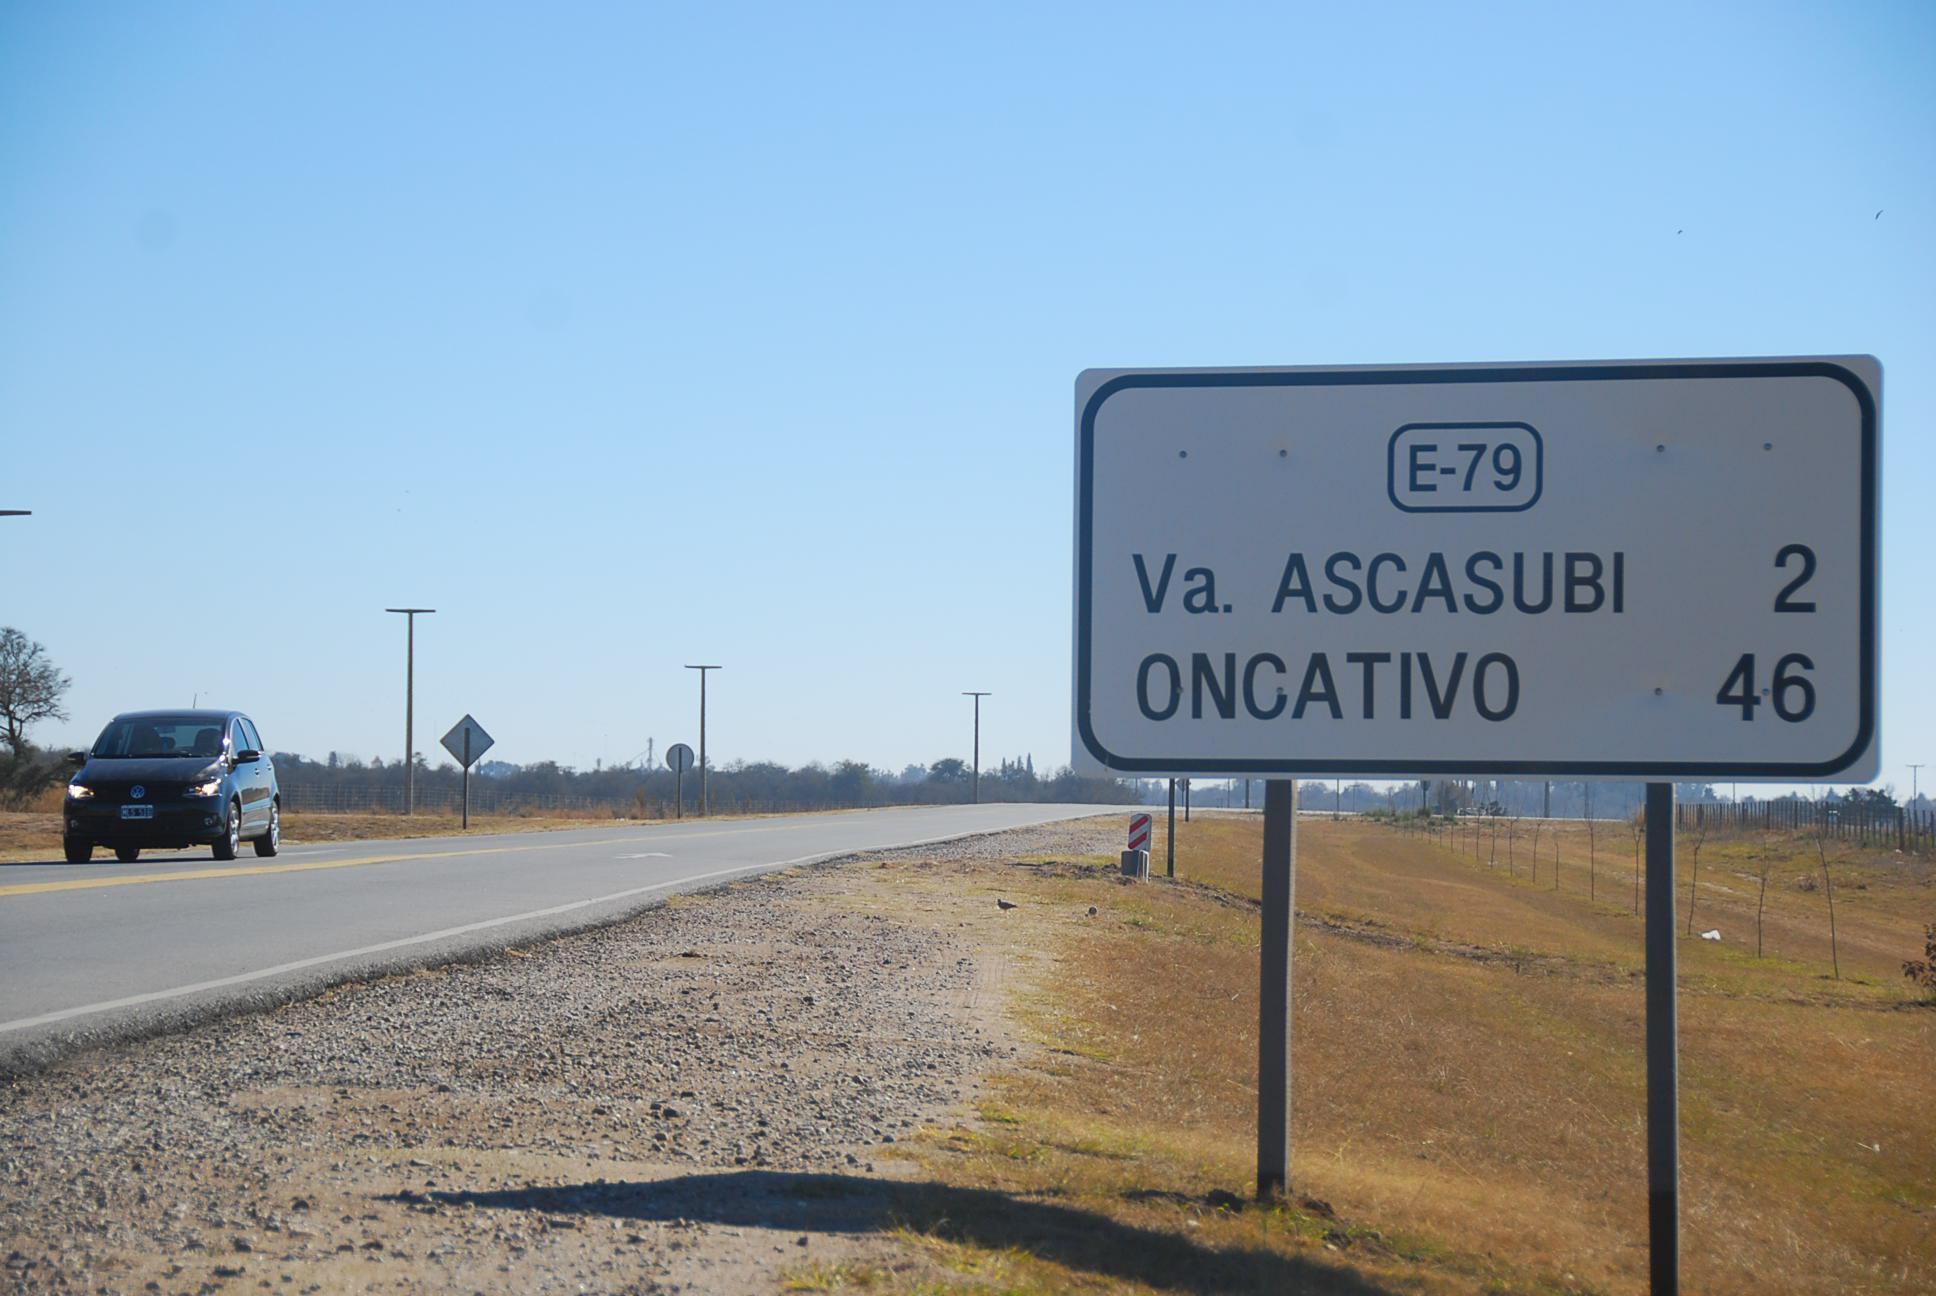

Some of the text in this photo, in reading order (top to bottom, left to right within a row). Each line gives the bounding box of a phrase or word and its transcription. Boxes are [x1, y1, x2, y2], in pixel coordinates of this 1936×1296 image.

[1409, 442, 1523, 493] E-79
[1131, 543, 1818, 616] Va. ASCASUBI 2
[1136, 651, 1817, 723] ONCATIVO 46
